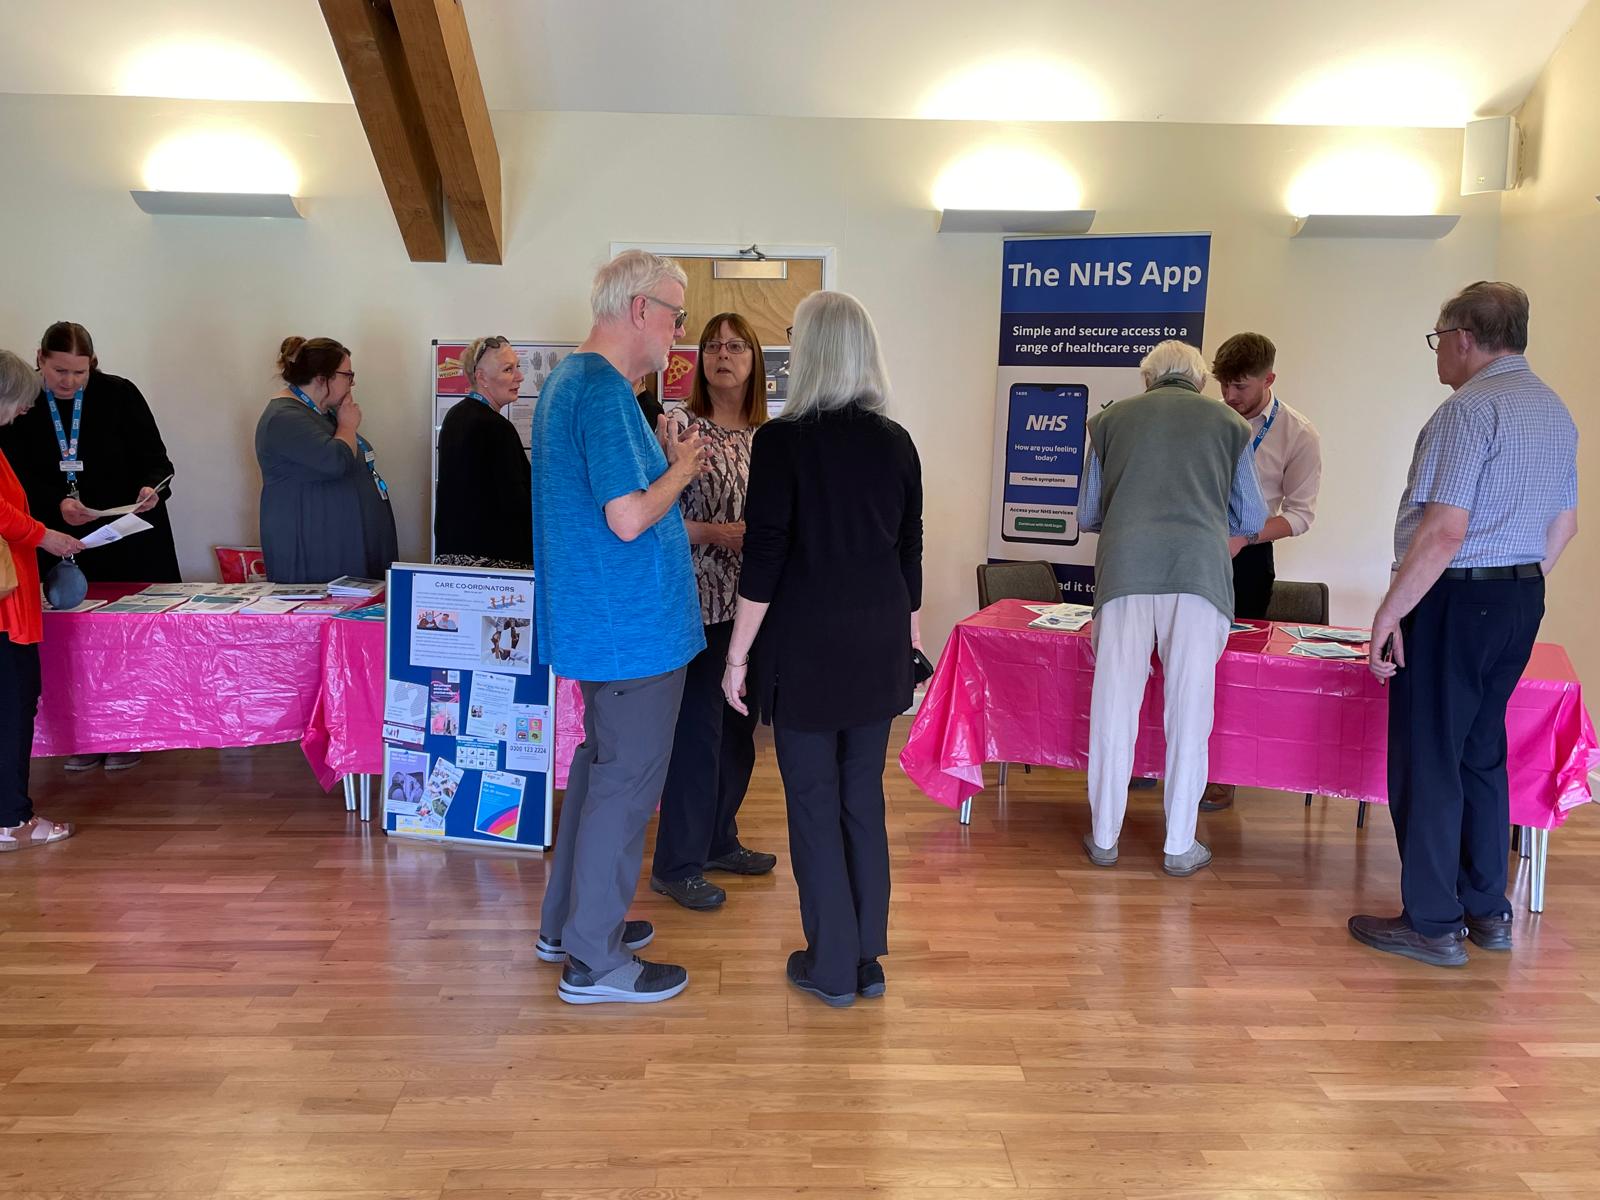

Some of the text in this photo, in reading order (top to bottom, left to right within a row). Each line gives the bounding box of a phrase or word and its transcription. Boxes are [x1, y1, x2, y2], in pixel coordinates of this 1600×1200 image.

[1008, 261, 1202, 293] The NHS App
[1012, 325, 1188, 339] Simple and secure access to a
[1015, 344, 1049, 355] range
[1050, 342, 1064, 353] of
[1065, 342, 1130, 353] healthcare
[1026, 415, 1068, 432] NHS
[1041, 446, 1054, 454] you
[1054, 445, 1078, 454] feeling
[1035, 455, 1058, 463] today?
[434, 581, 455, 589] CARE
[455, 583, 515, 592] CO-ORDINATORS
[1074, 581, 1083, 592] it
